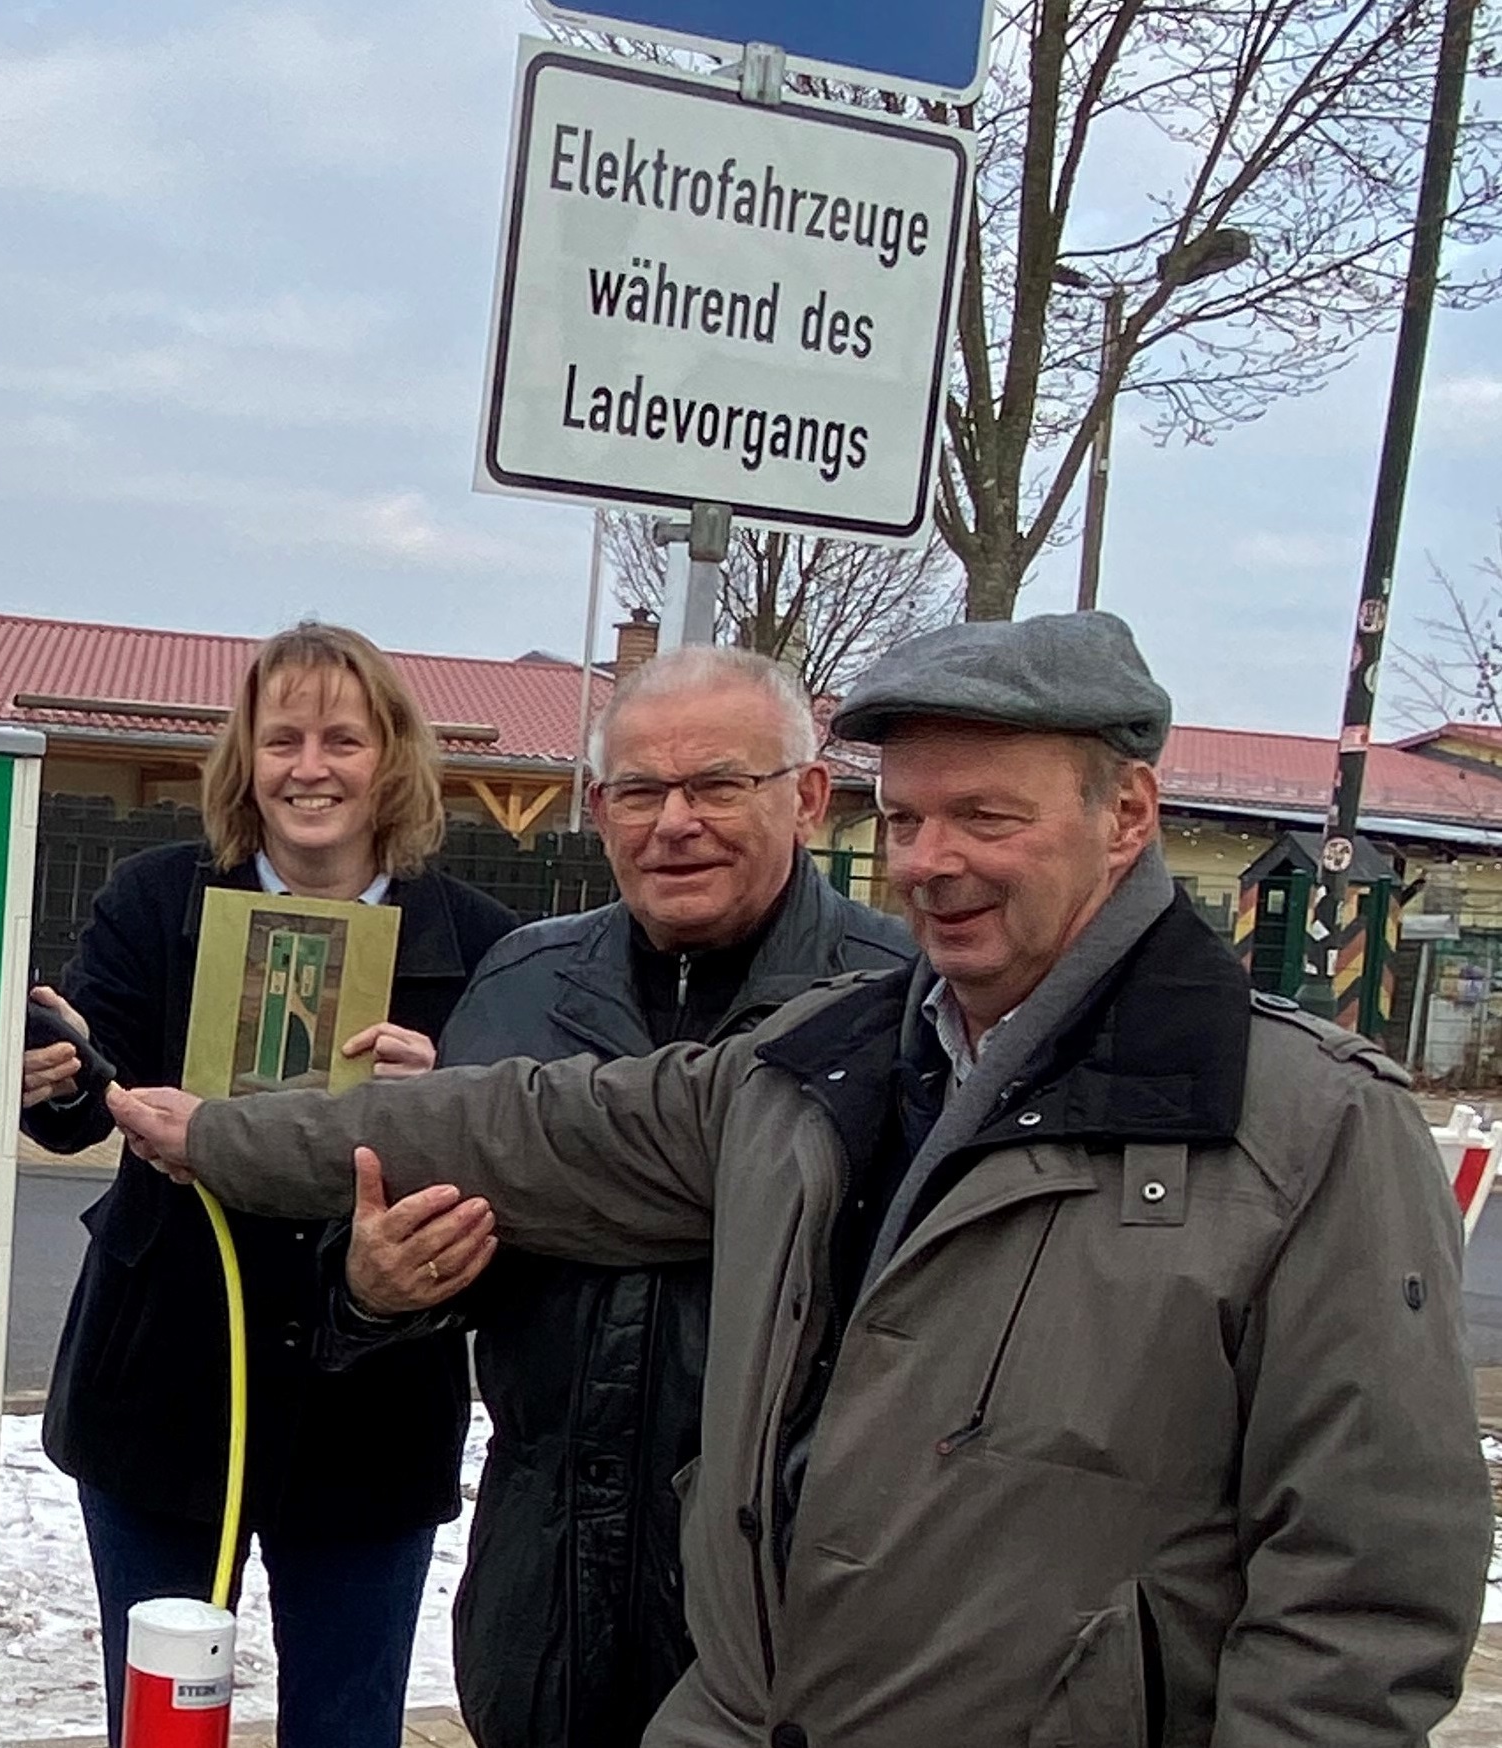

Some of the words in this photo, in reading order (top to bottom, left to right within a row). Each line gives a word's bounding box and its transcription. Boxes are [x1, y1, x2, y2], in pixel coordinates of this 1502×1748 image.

[549, 123, 929, 268] Elektrofahrzeuge
[589, 257, 780, 344] während
[801, 290, 874, 359] des
[562, 364, 869, 482] Ladevorgangs
